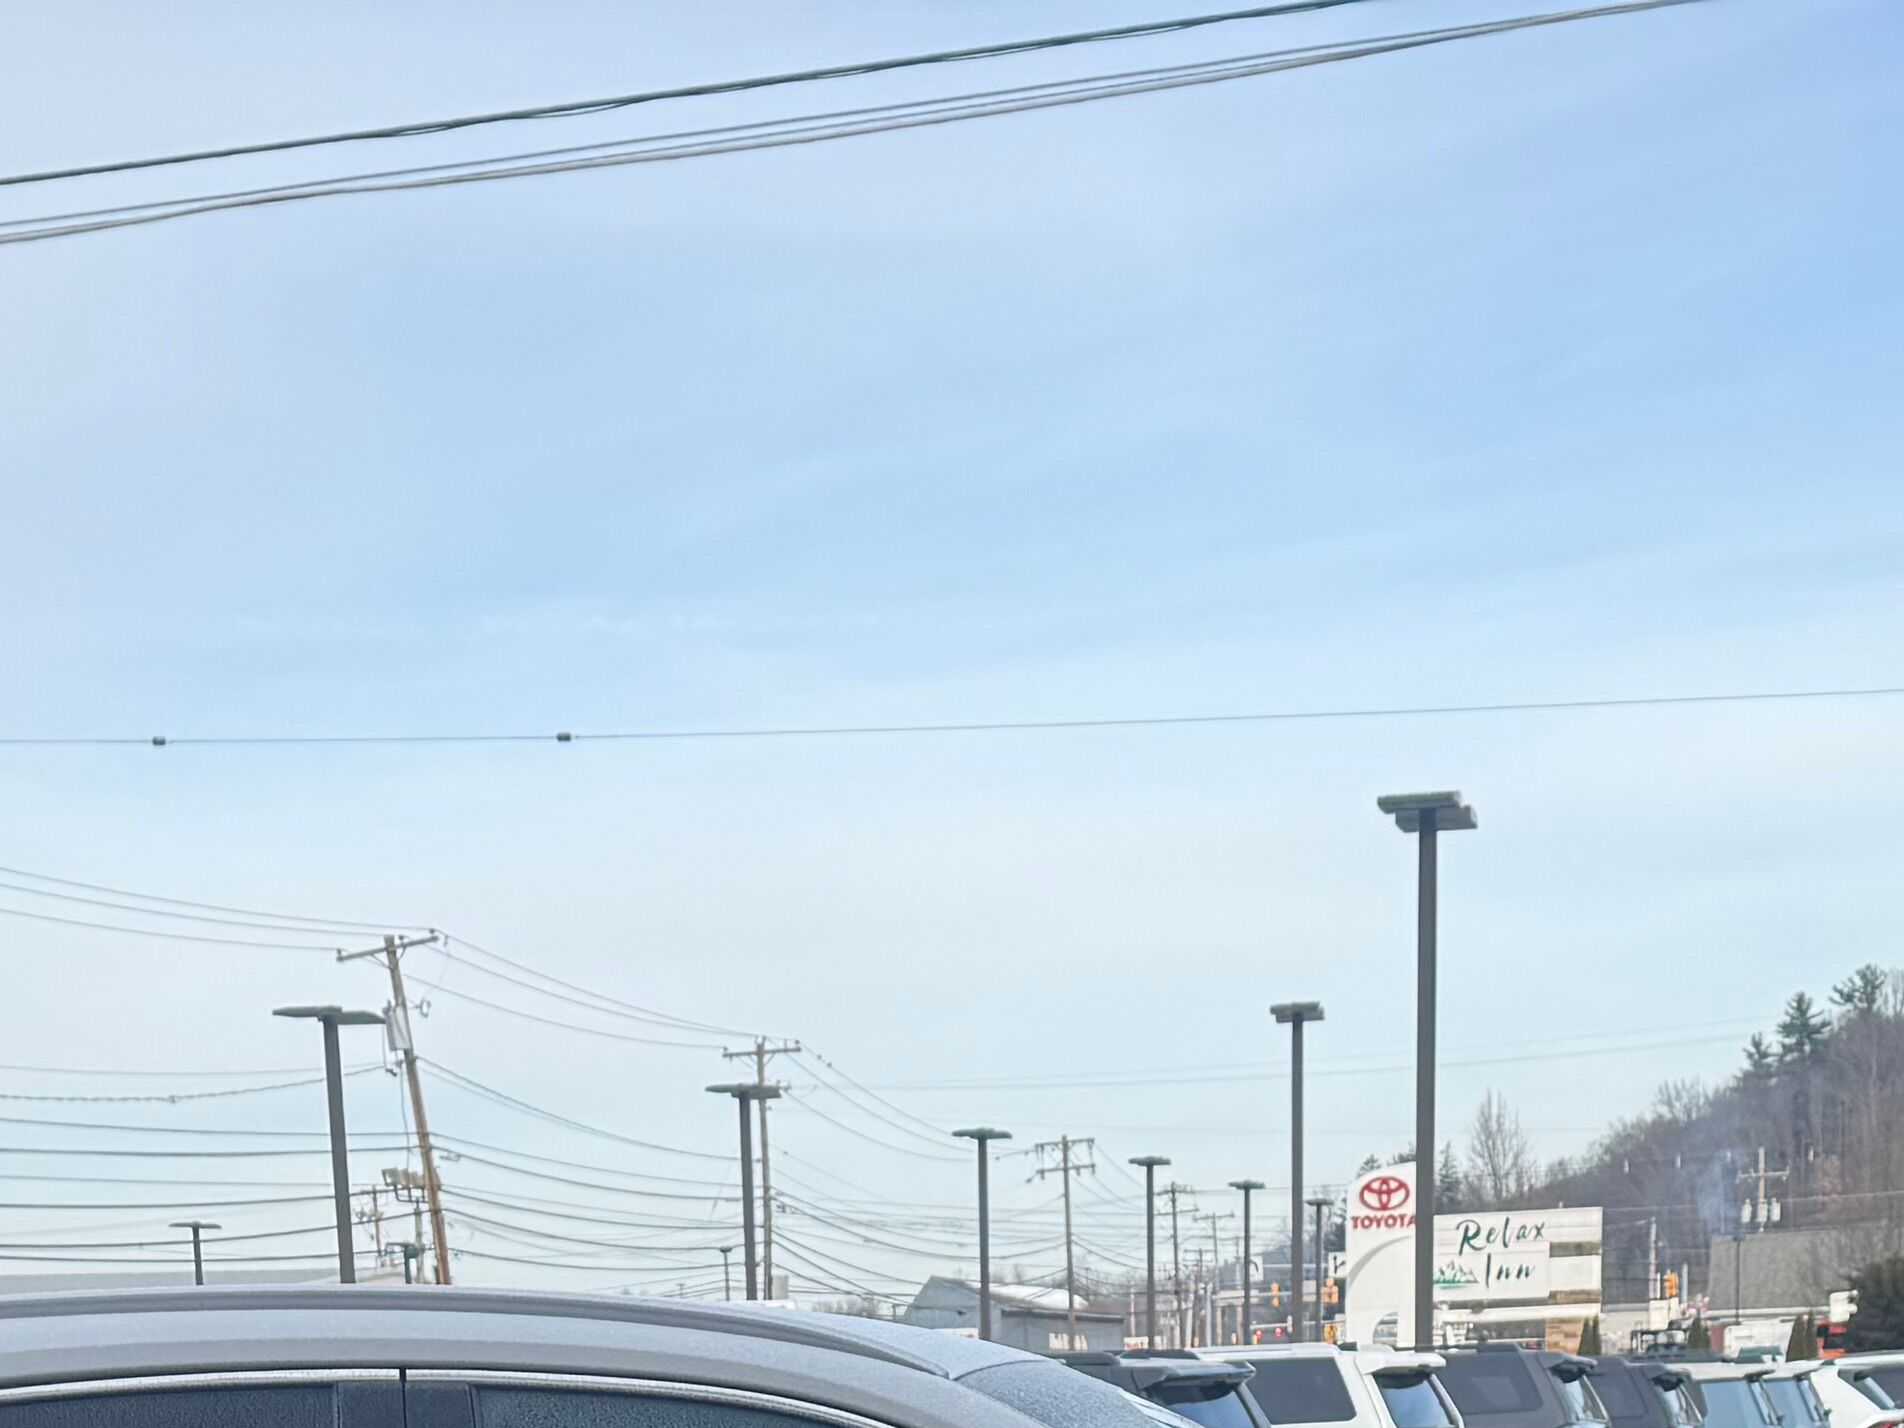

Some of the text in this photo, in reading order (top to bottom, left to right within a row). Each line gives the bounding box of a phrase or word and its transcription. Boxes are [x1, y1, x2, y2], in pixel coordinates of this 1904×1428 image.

[1351, 1214, 1416, 1229] TOYOTA
[1456, 1217, 1544, 1256] Relax
[1484, 1253, 1535, 1288] Inn
